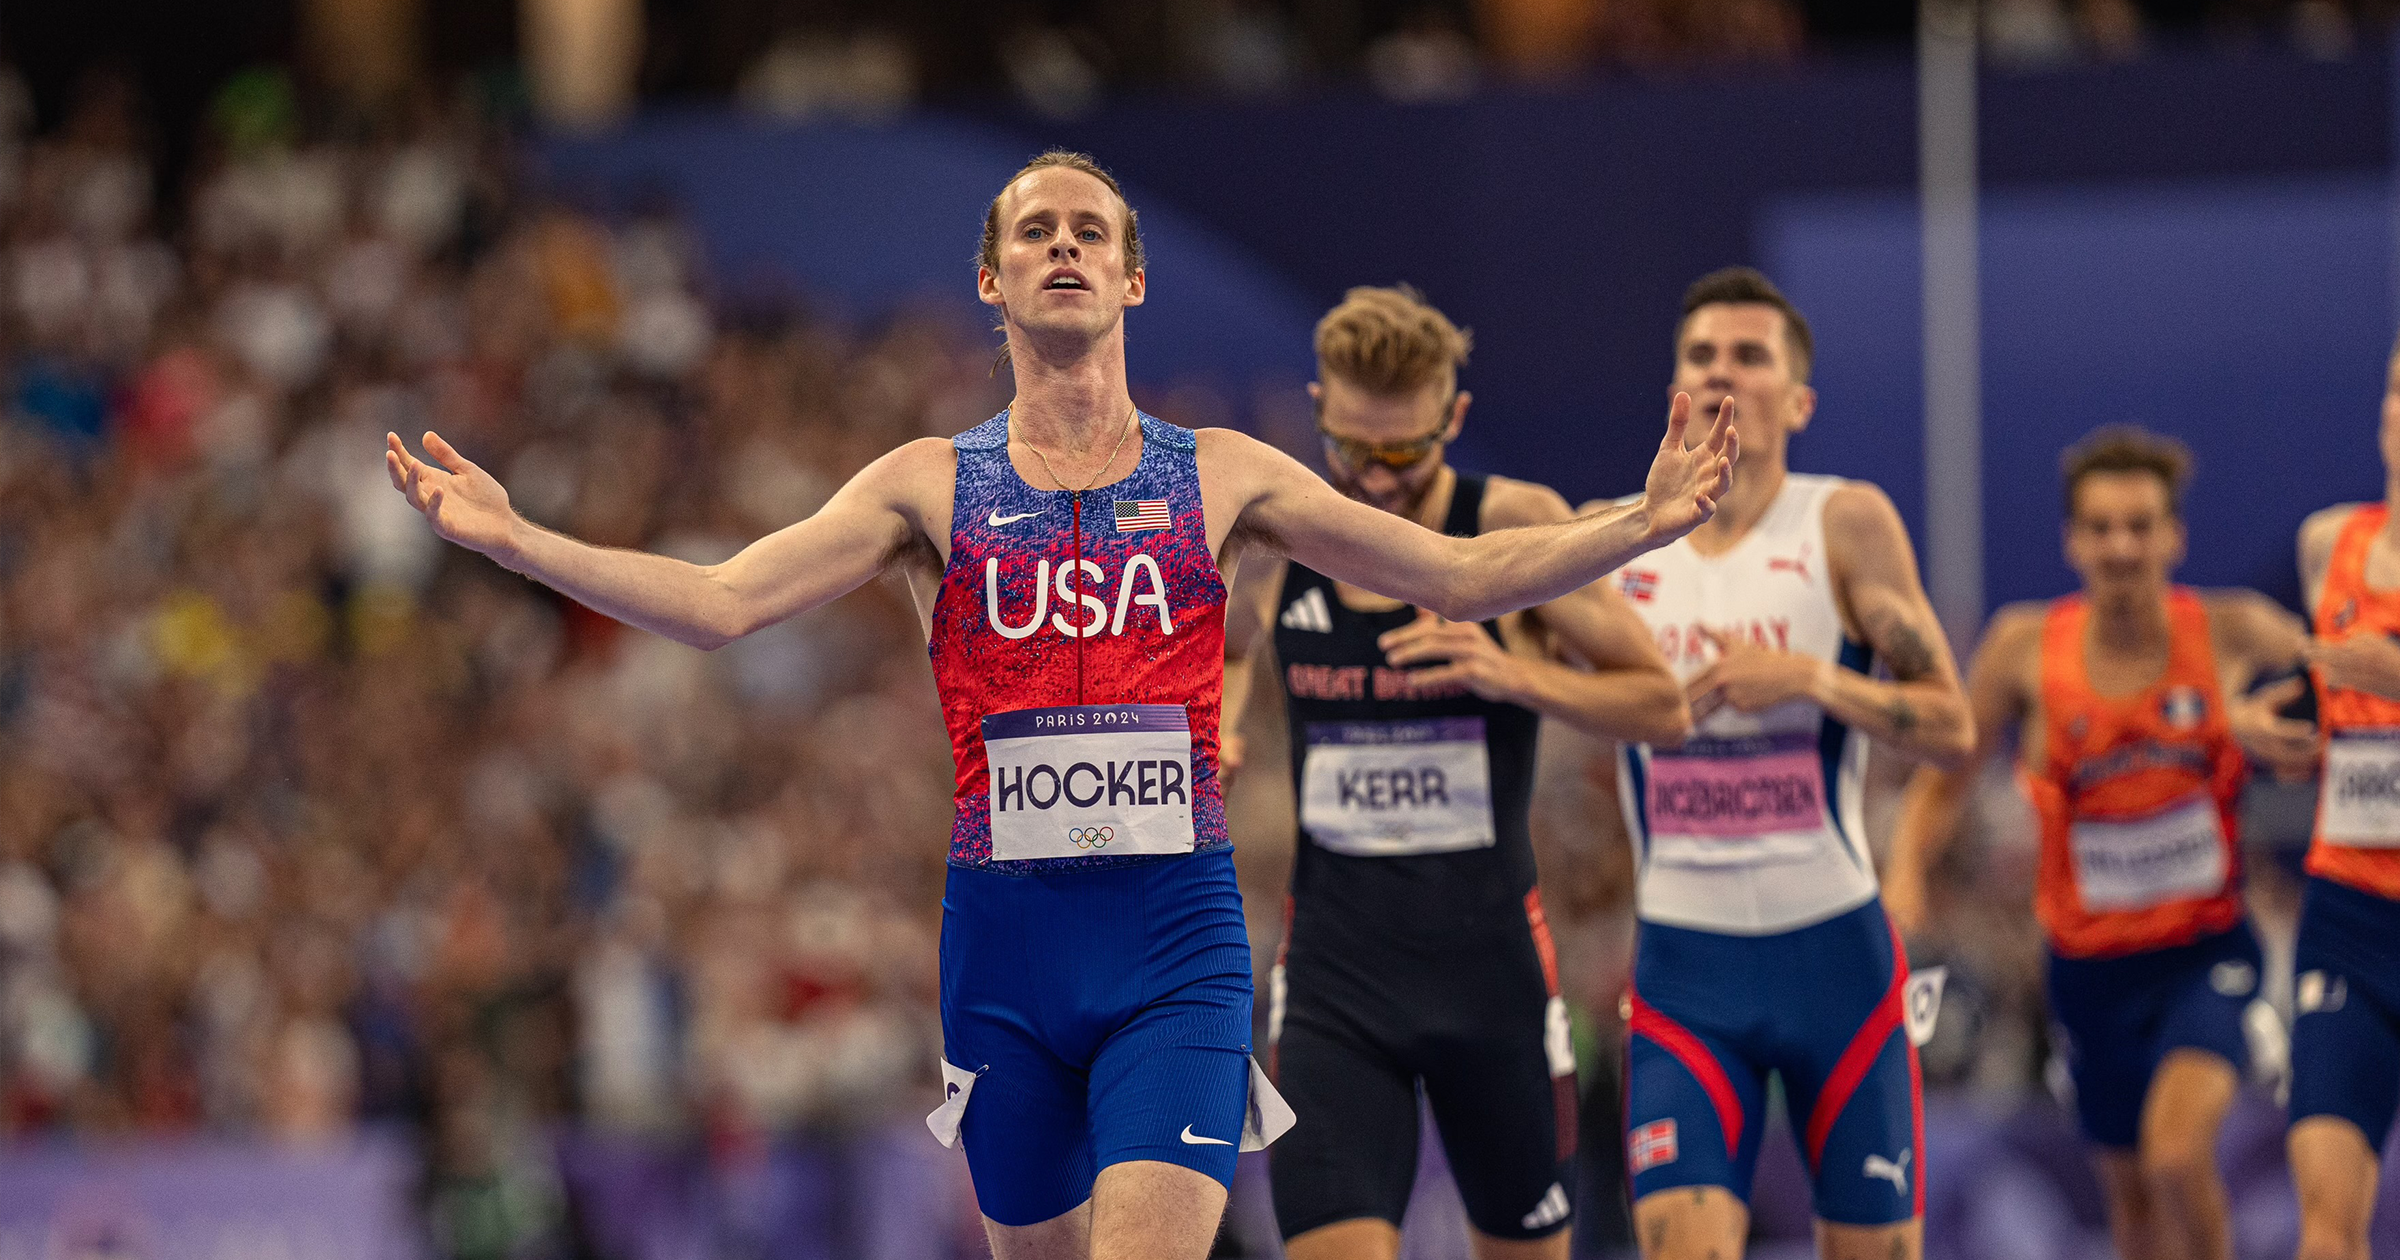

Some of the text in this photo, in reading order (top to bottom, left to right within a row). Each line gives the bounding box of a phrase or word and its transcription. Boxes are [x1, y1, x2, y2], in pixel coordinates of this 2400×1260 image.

[985, 554, 1174, 639] USA
[997, 759, 1188, 812] HOCKER
[1336, 764, 1449, 811] KERR
